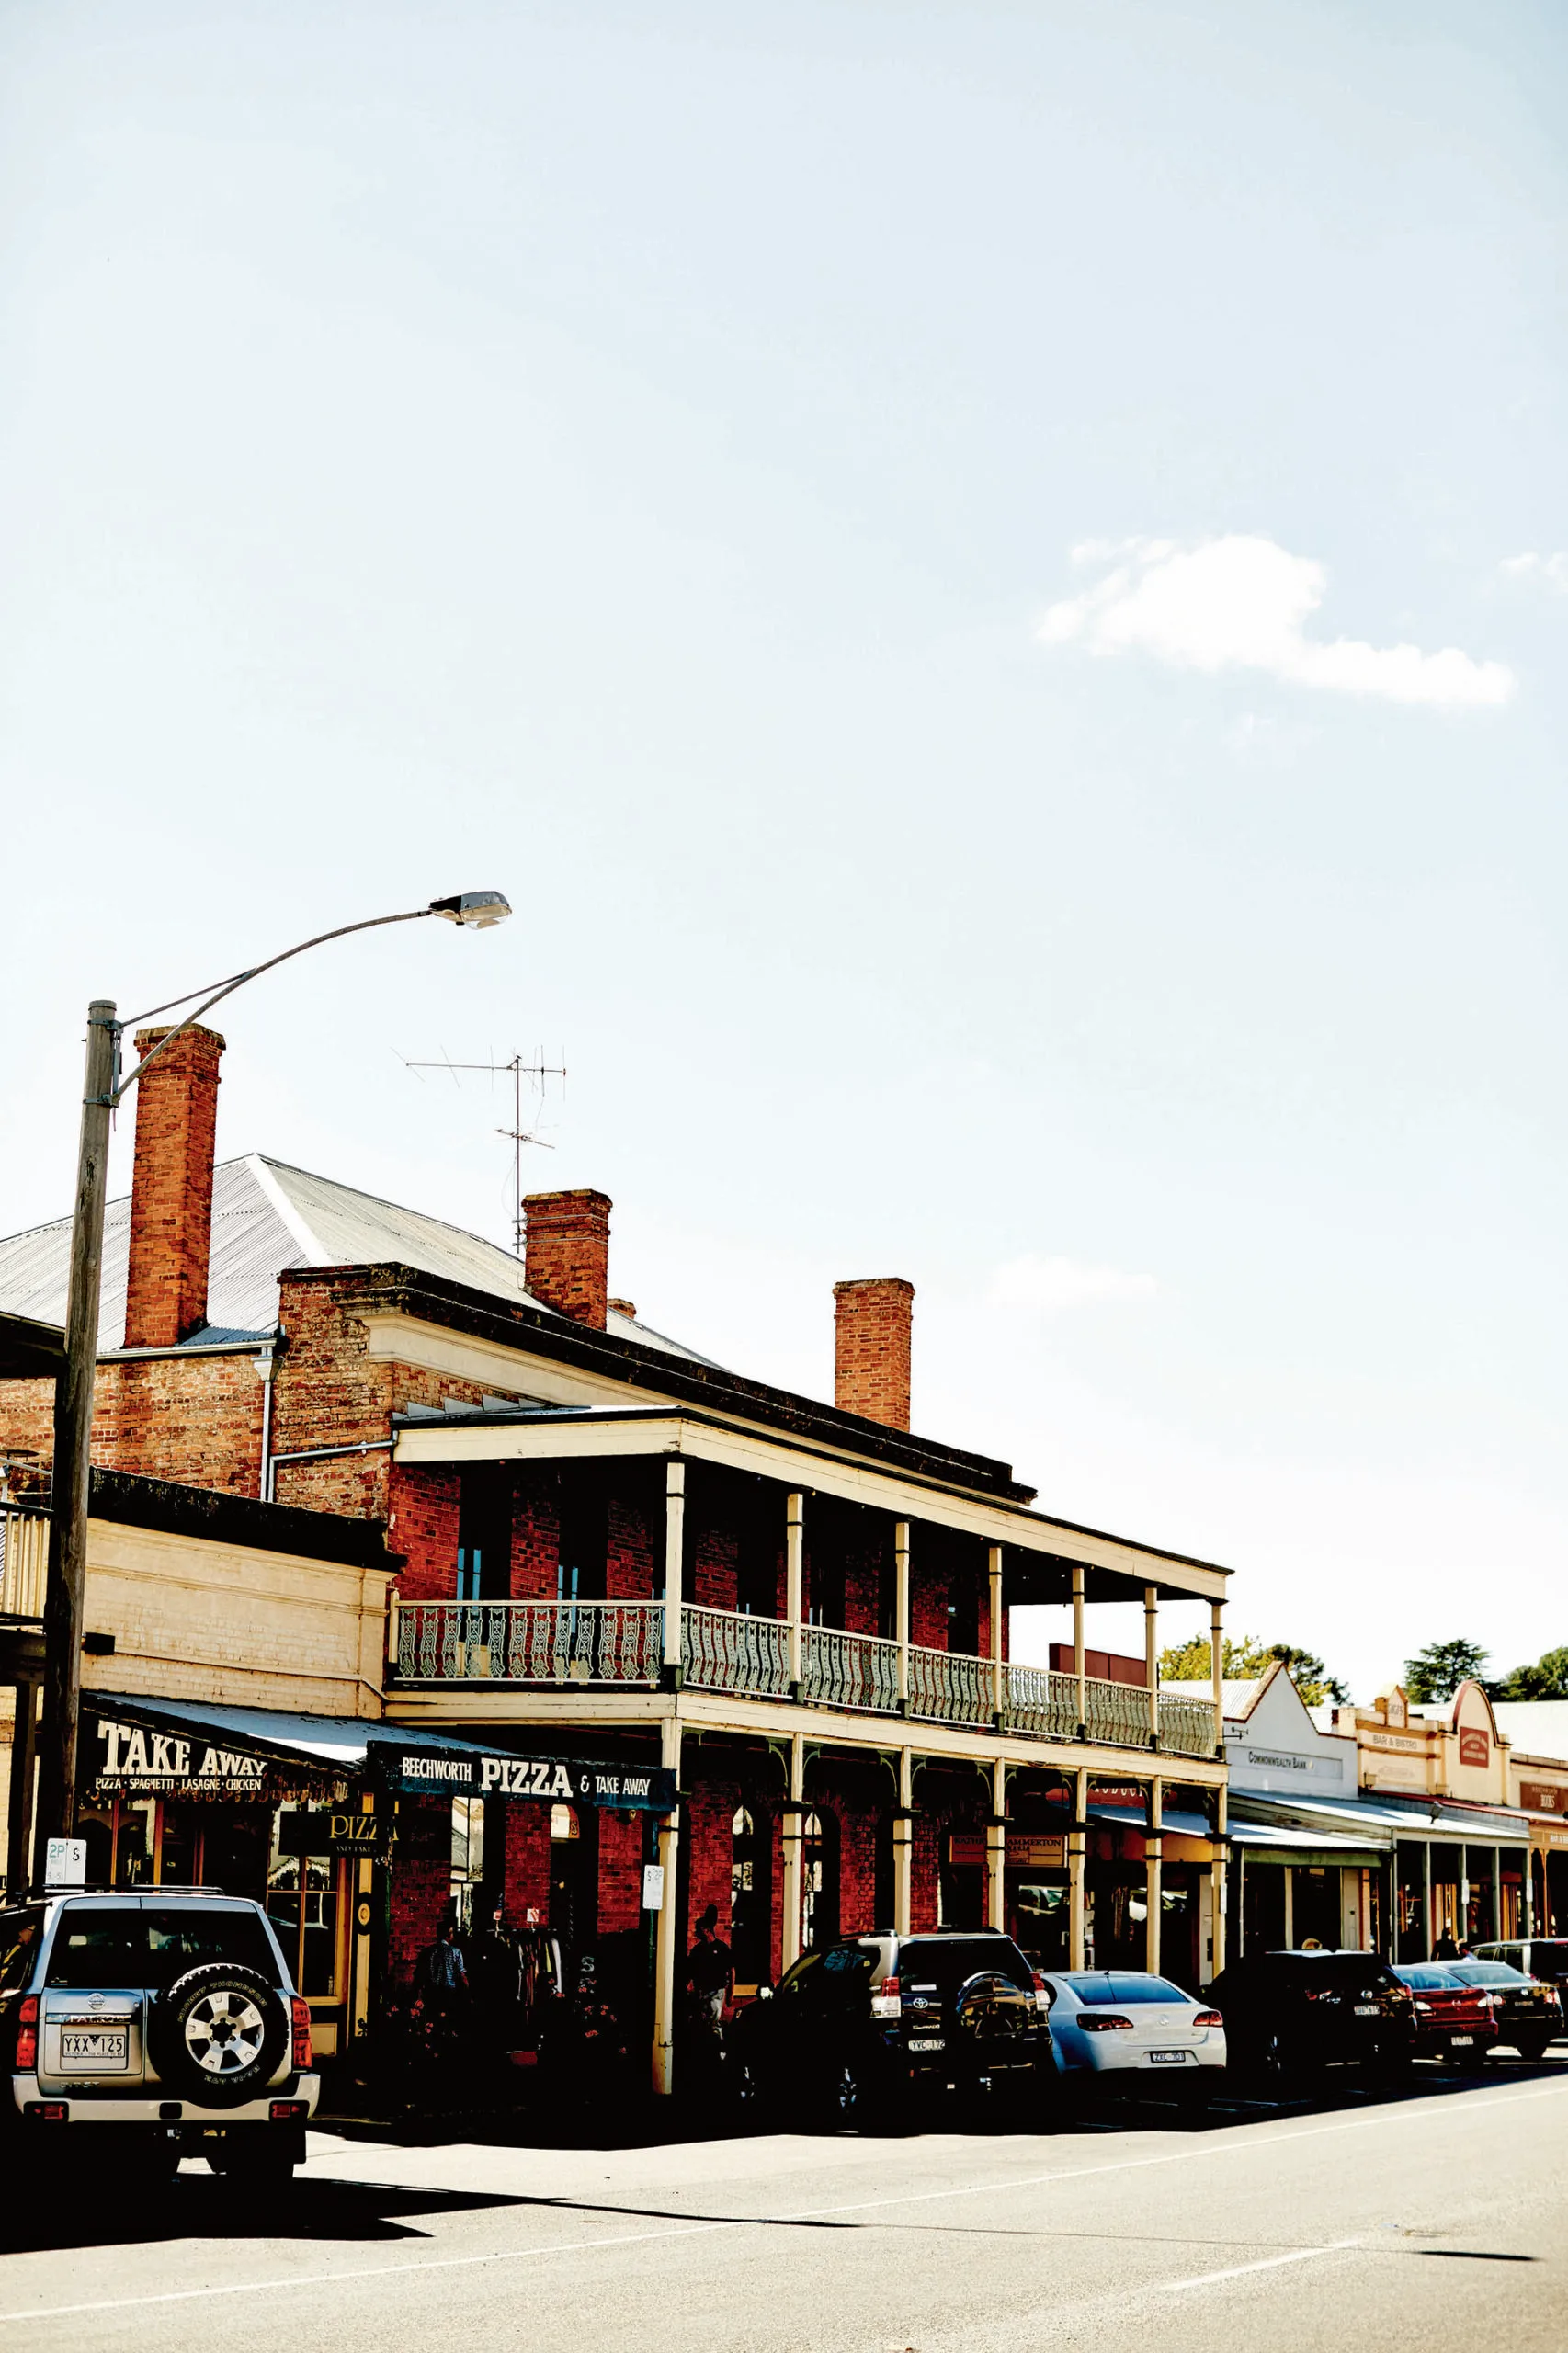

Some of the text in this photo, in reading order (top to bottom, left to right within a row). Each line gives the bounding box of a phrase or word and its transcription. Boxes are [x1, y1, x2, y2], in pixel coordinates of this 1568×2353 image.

[97, 1719, 268, 1776] TAKE AWAY
[1373, 1734, 1417, 1749] BAR & BISTRO
[1292, 1757, 1307, 1769] BANK
[95, 1777, 262, 1790] PIZZA SPAGHETTI LASAGNE CHICKEN
[402, 1756, 651, 1798] BEECHWORTH PIZZA & TAKE AWAY
[1008, 1837, 1062, 1847] AMMERTON
[50, 1844, 65, 1858] 2P
[65, 2038, 122, 2052] YXX 125
